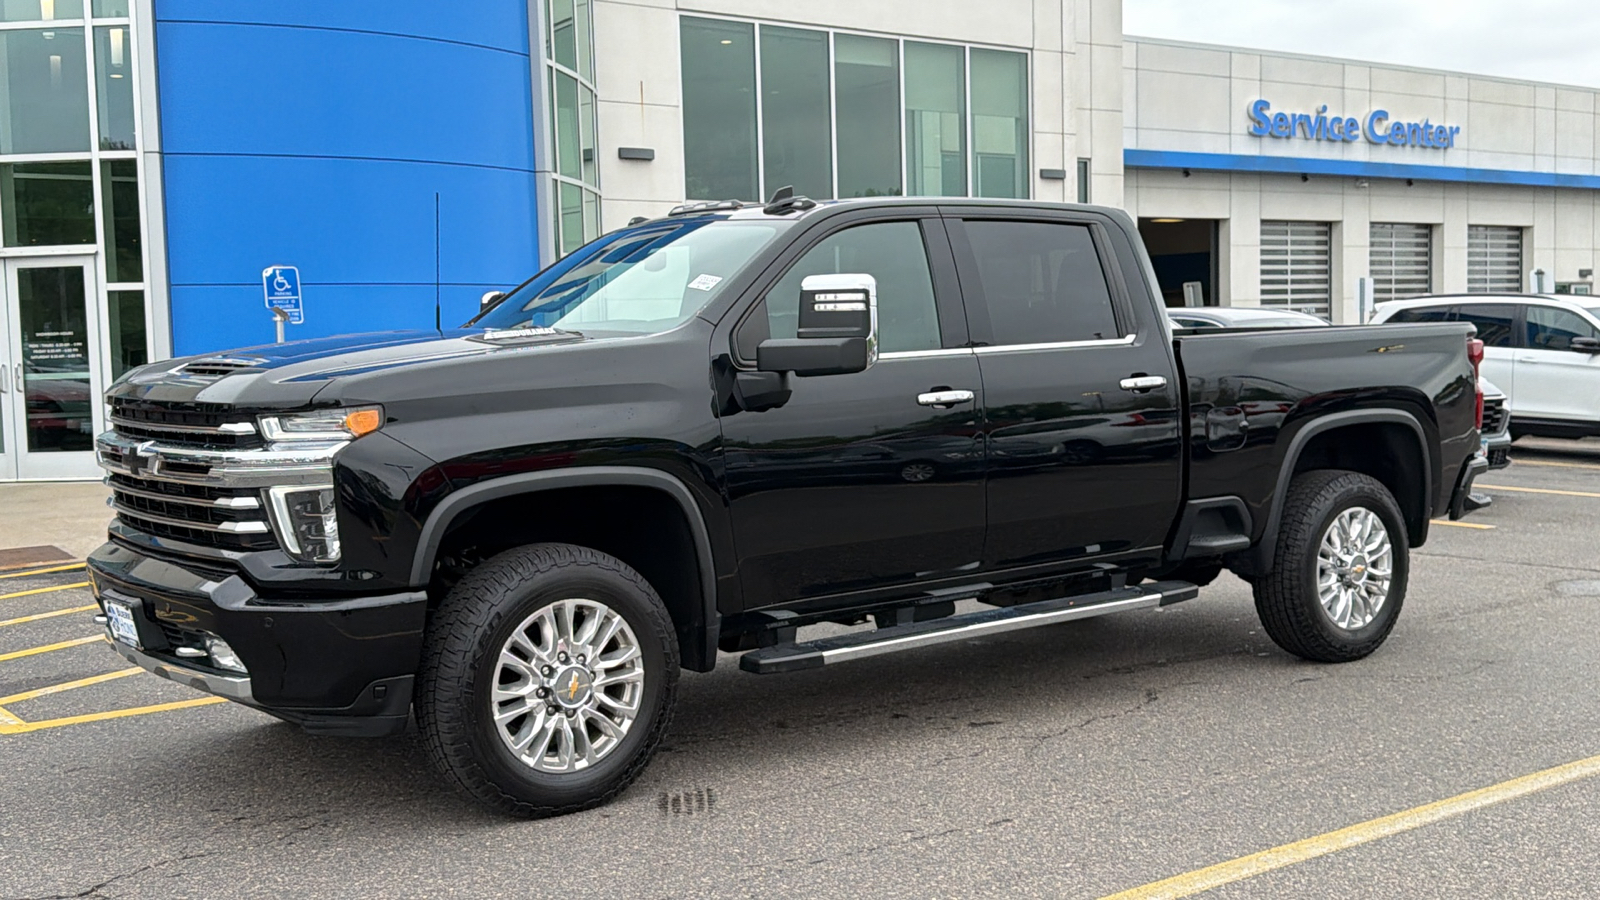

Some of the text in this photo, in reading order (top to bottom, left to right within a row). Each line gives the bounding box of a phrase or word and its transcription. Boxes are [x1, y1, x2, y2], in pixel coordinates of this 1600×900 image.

[1248, 99, 1460, 149] Service Center
[513, 327, 556, 336] DURAMAX
